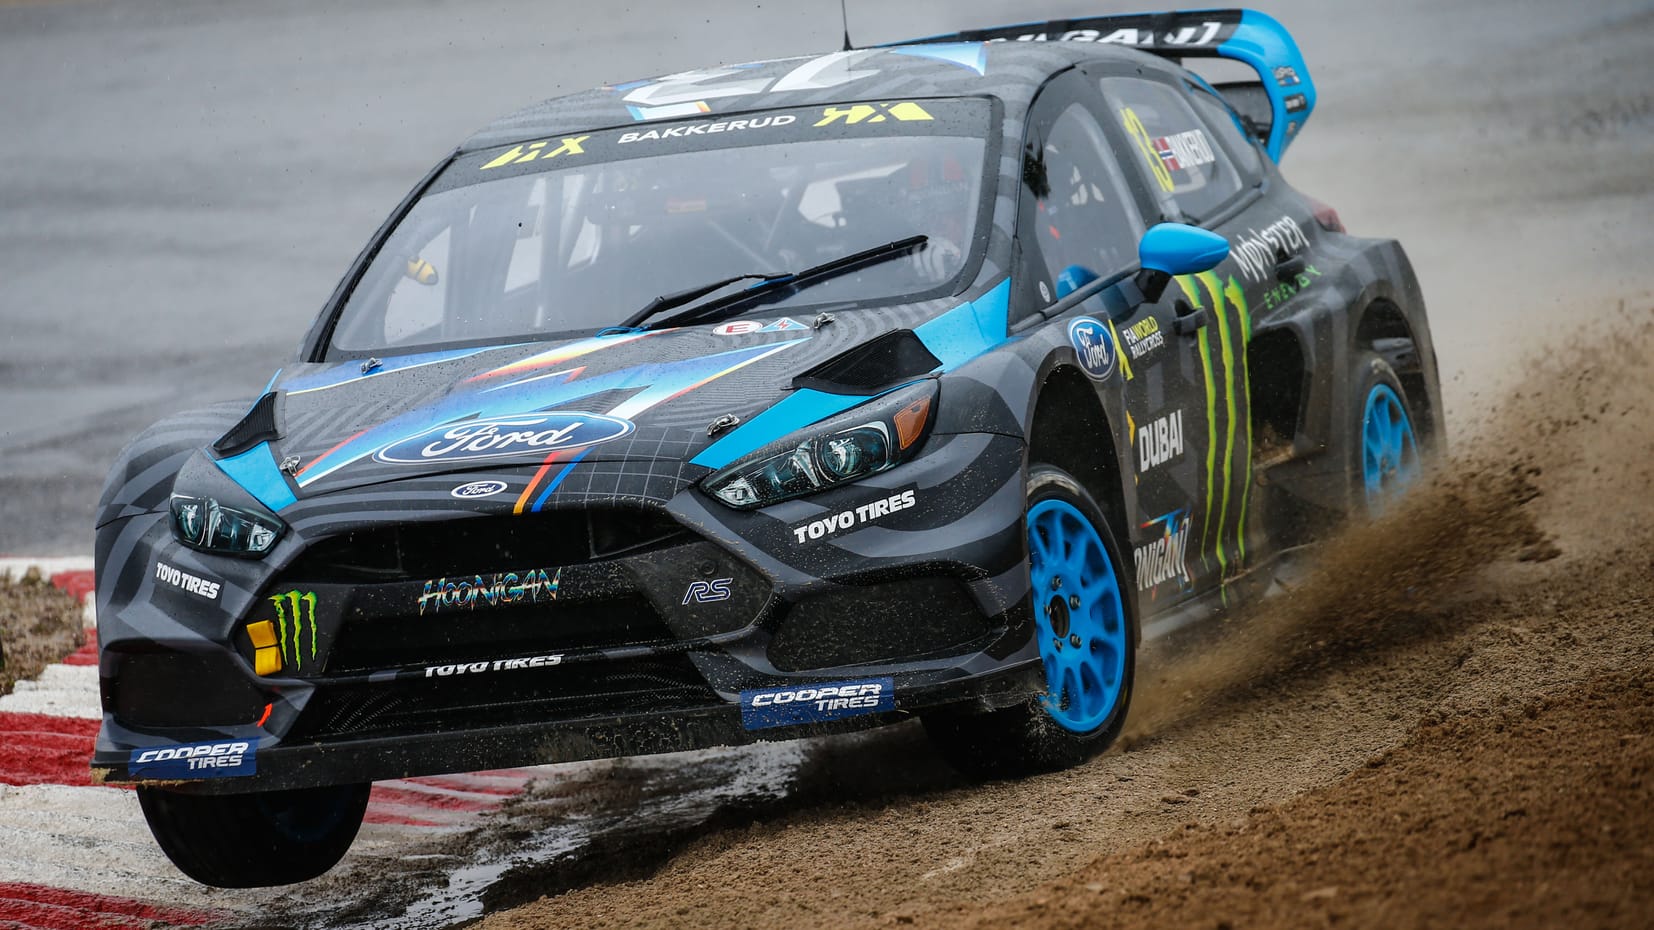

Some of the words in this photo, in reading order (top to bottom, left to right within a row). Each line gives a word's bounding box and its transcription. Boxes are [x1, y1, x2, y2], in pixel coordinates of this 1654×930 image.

[617, 115, 796, 144] BAKKERUD
[1229, 215, 1311, 284] MONSTER
[1076, 326, 1110, 369] Ford
[1130, 331, 1165, 360] RALLYCROSS
[421, 417, 585, 458] Ford
[1138, 409, 1184, 473] DUBAI
[461, 483, 498, 496] Ford
[793, 510, 855, 544] TOYO
[856, 489, 916, 523] TIRES
[156, 562, 181, 586] TOYO
[181, 572, 221, 600] TIRES
[681, 577, 734, 606] RS
[425, 661, 490, 678] TOYO
[493, 653, 565, 672] TIRES
[751, 683, 883, 707] COOPER
[815, 695, 881, 712] TIRES
[136, 742, 249, 764] COOPER
[187, 754, 244, 770] TIRES
